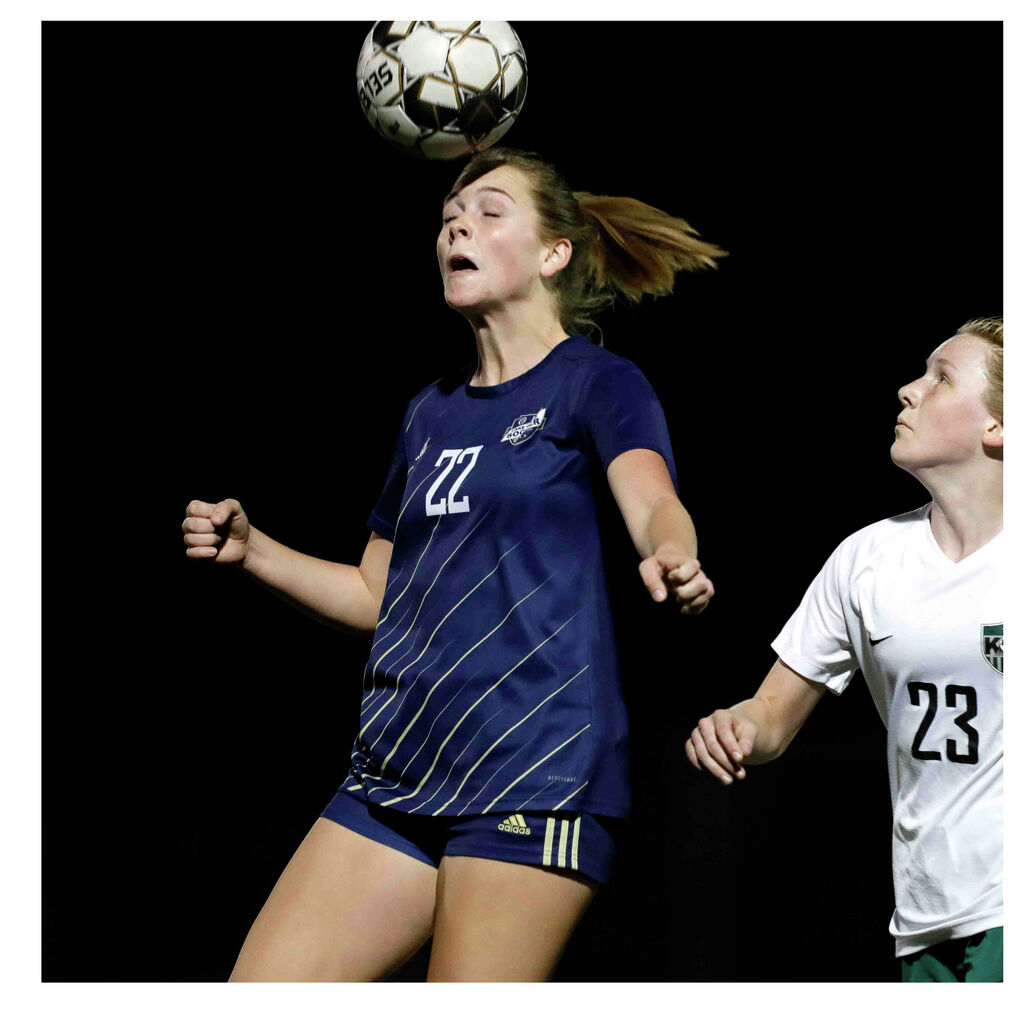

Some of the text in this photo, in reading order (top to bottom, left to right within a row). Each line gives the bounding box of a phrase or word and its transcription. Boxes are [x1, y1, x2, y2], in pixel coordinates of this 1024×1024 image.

[425, 445, 484, 517] 22
[907, 681, 979, 765] 23
[498, 823, 531, 835] adidas
